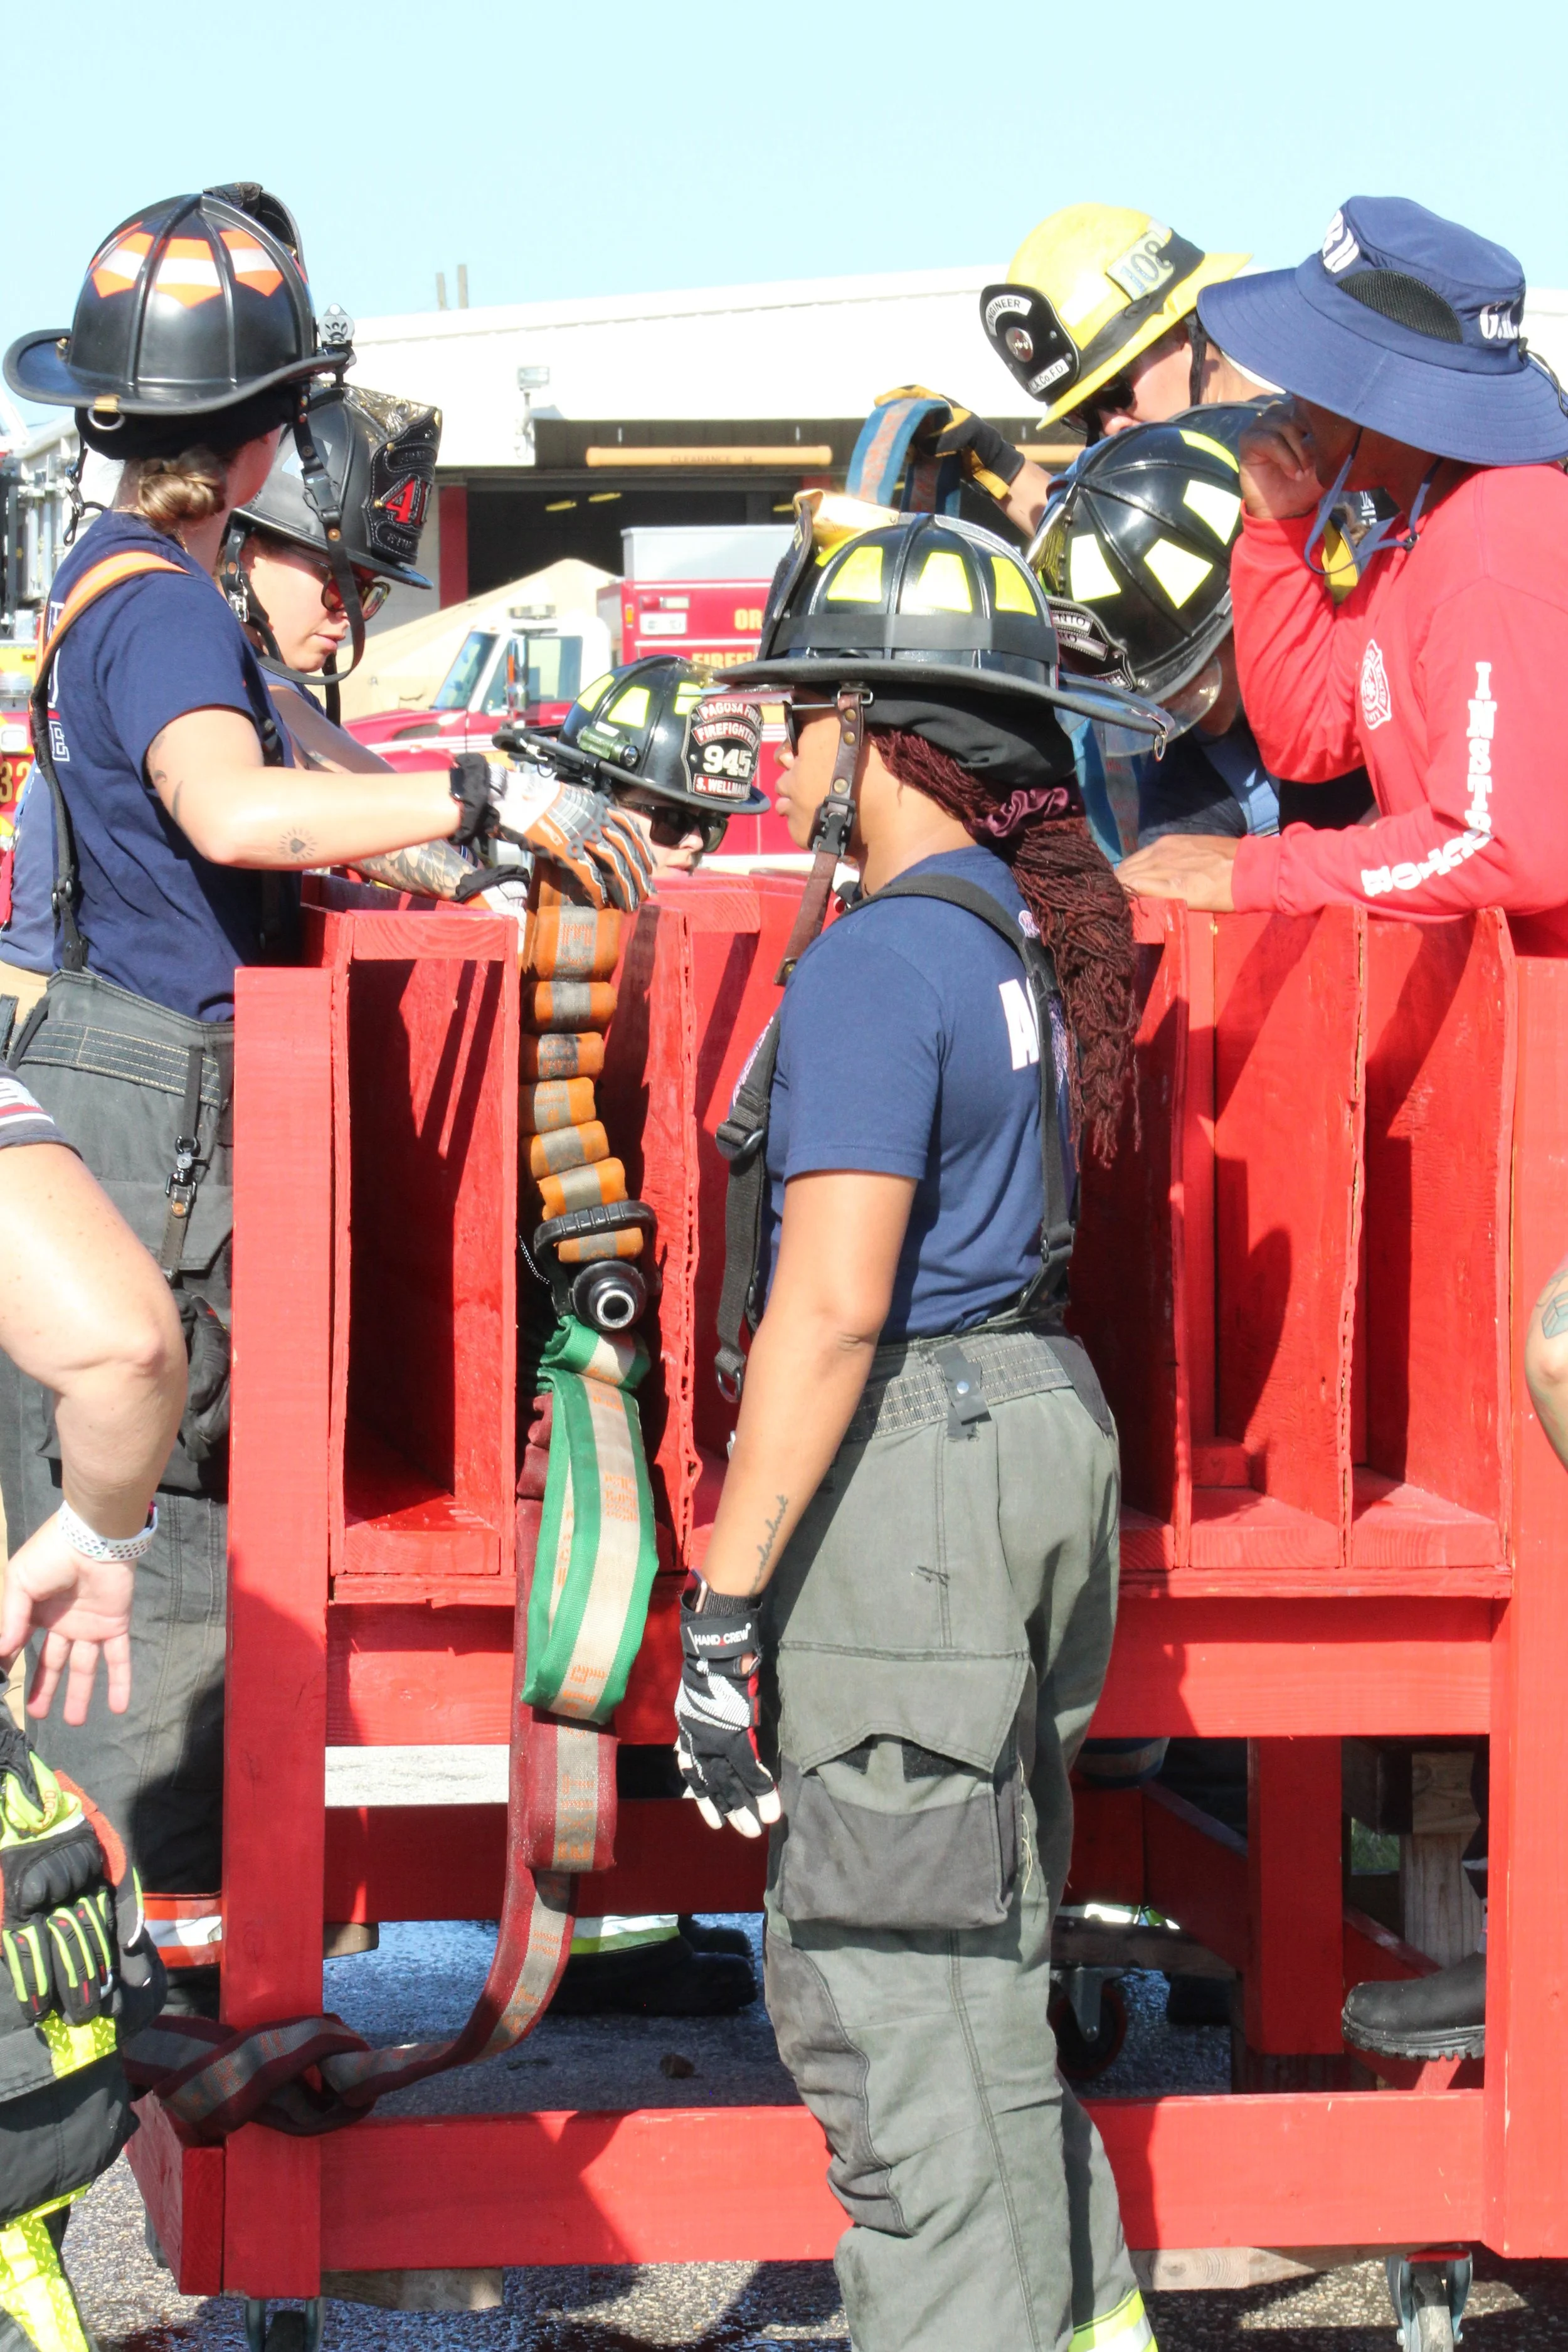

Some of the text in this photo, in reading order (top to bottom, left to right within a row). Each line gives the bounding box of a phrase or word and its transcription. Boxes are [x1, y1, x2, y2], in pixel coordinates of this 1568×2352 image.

[988, 298, 1021, 326] ENGINEER
[701, 702, 744, 721] PAGOSA
[696, 722, 757, 749] FIREFIGHTER
[702, 744, 753, 778] 945
[696, 776, 747, 796] S. WELLMAN
[694, 1629, 748, 1647] HAND CREW
